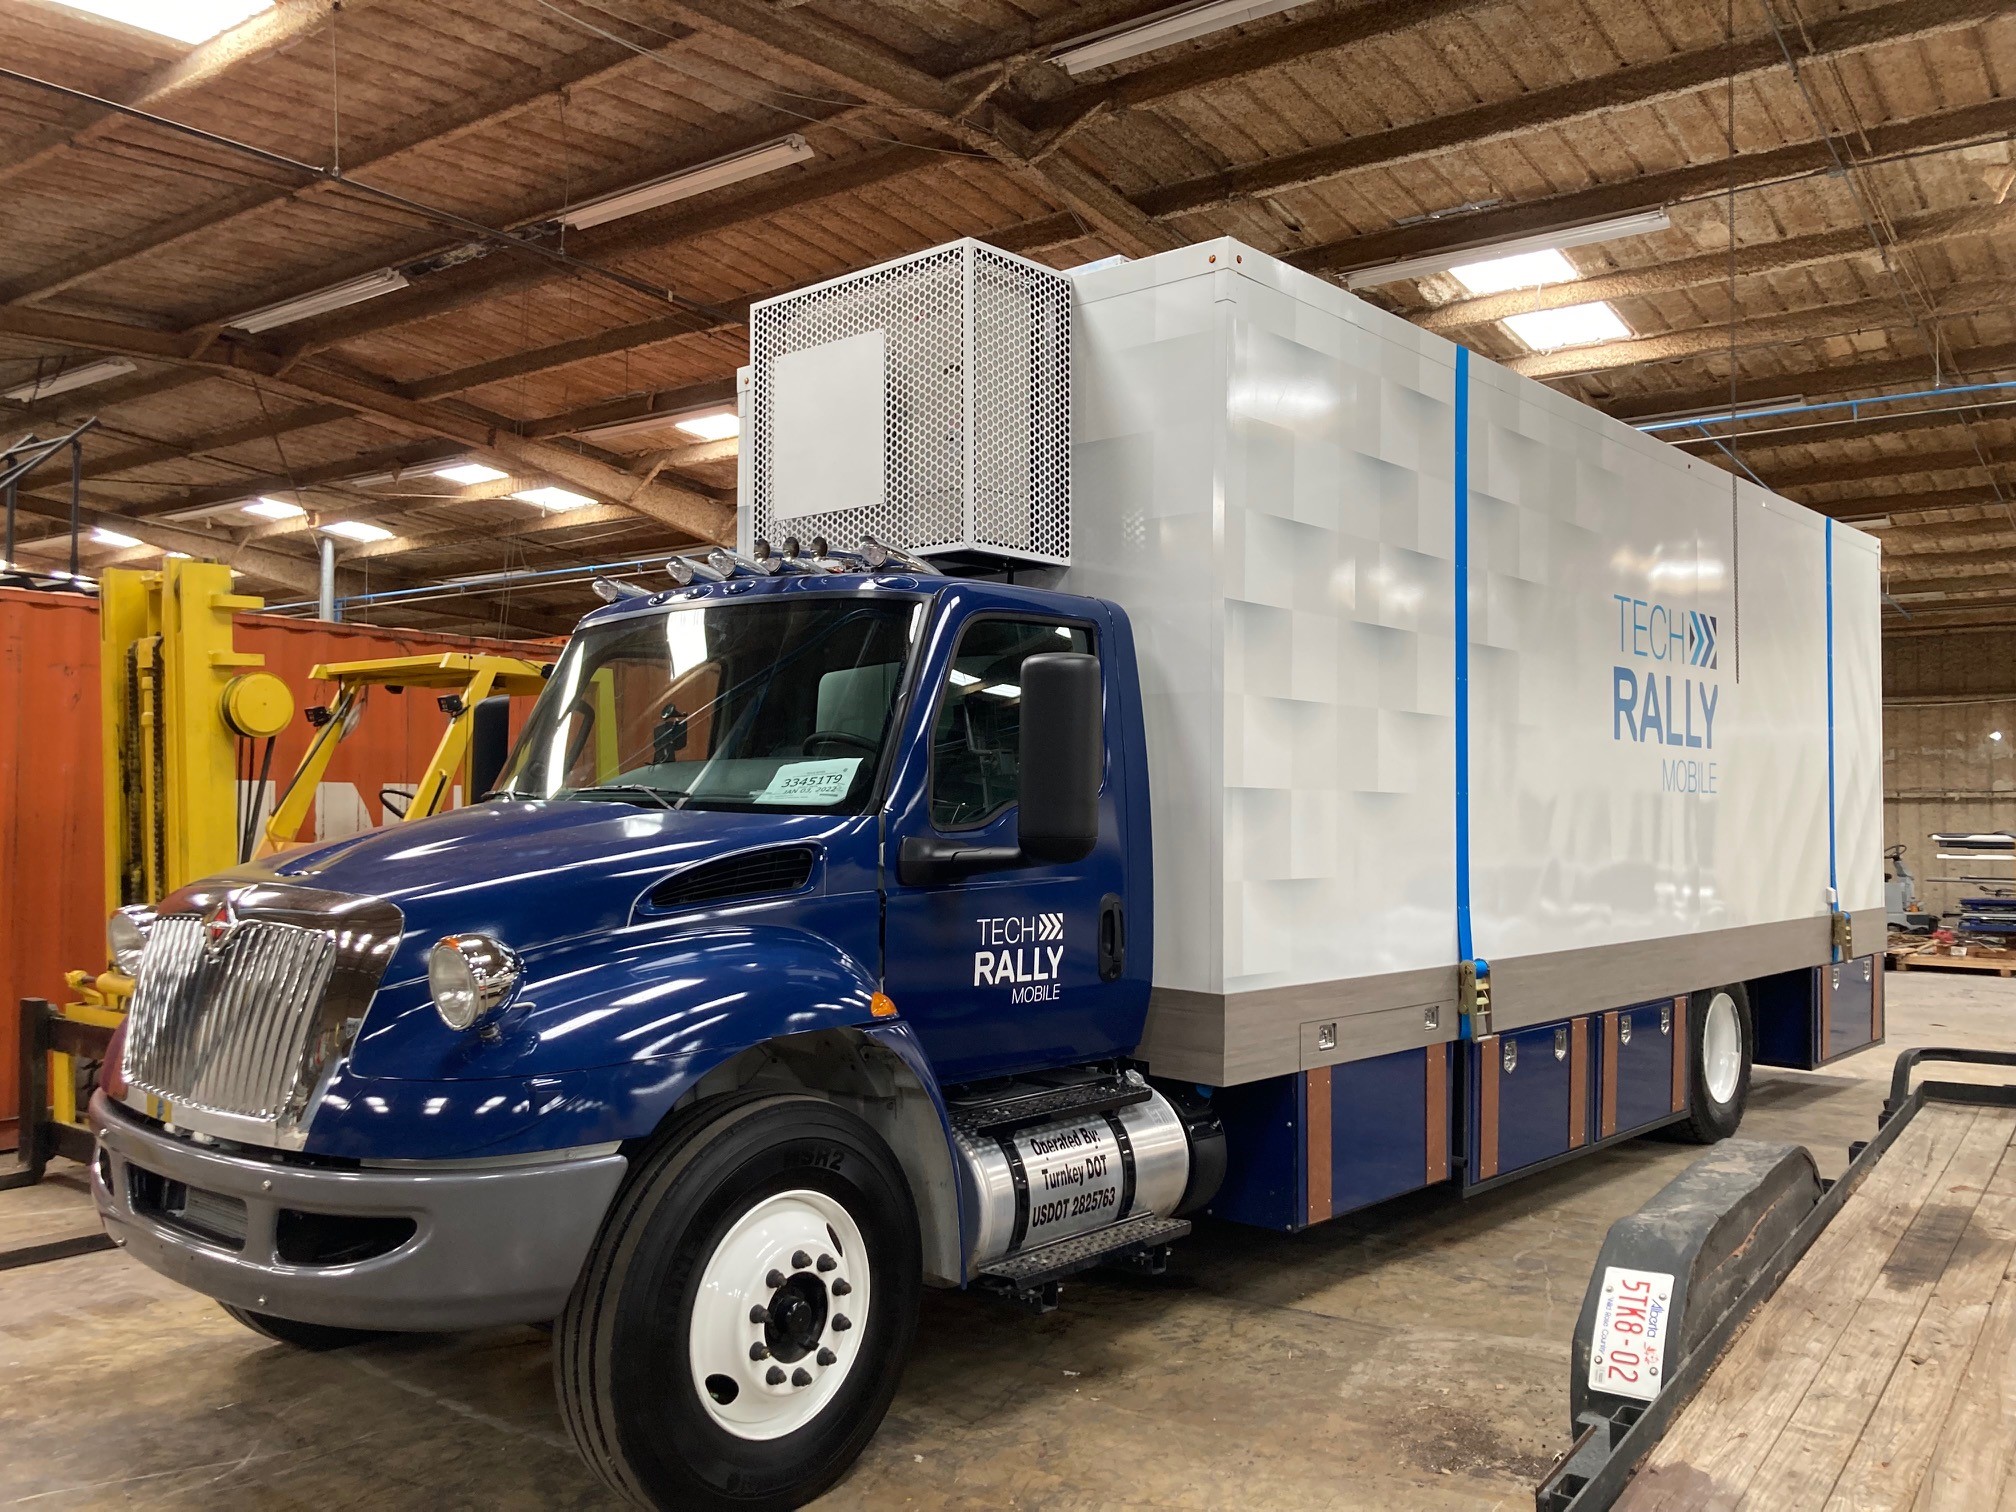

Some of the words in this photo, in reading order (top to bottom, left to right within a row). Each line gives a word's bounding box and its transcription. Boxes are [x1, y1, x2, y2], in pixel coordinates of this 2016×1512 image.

[1613, 593, 1685, 664] TECH
[1613, 665, 1718, 749] RALLY
[781, 774, 843, 788] 33451T9
[1662, 758, 1717, 794] MOBILE
[976, 916, 1035, 946] TECH
[974, 945, 1064, 986] RALLY
[1011, 983, 1061, 1004] MOBILE
[1030, 1129, 1082, 1160] Operated
[1079, 1127, 1101, 1149] By:
[1041, 1163, 1084, 1190] Turnkey
[1085, 1154, 1107, 1179] DOT
[1032, 1198, 1071, 1228] USDOT
[1071, 1186, 1116, 1217] 2825763
[1603, 1312, 1612, 1327] Rose
[1607, 1279, 1651, 1383] 5TK8-02
[1646, 1299, 1665, 1338] Alberta
[1599, 1329, 1609, 1355] Country
